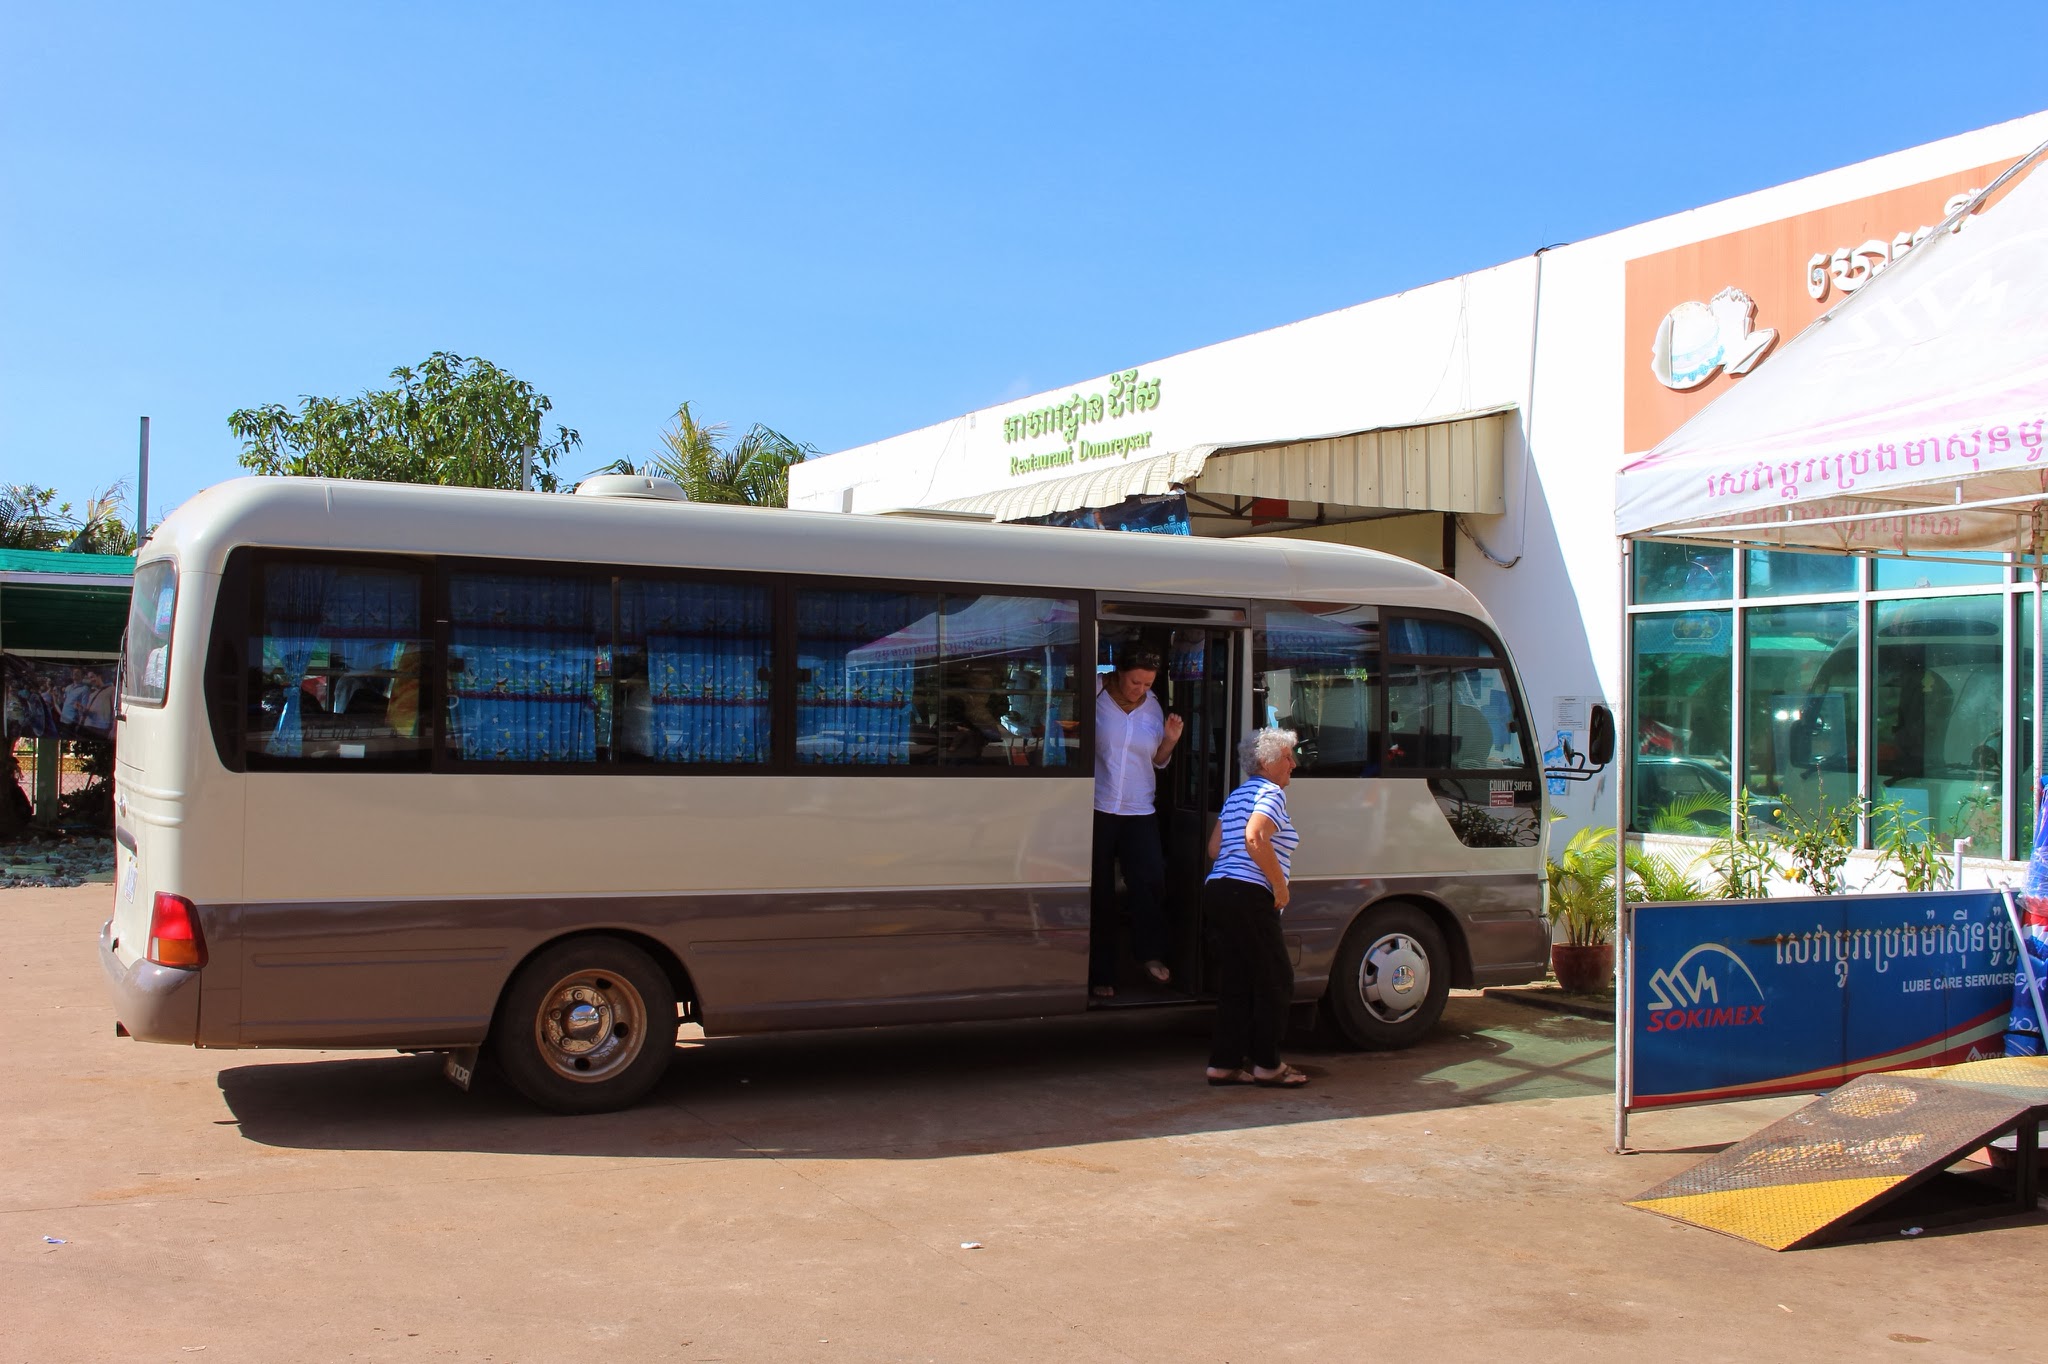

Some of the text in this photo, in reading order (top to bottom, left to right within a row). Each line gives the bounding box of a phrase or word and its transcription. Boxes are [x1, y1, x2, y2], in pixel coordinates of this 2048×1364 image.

[1009, 431, 1152, 476] Restaurant Domreysar
[1489, 780, 1532, 791] COUNTY SUPER
[1902, 972, 2015, 993] LUBE CARE SERVICES
[1646, 1005, 1766, 1033] SOKIMEX
